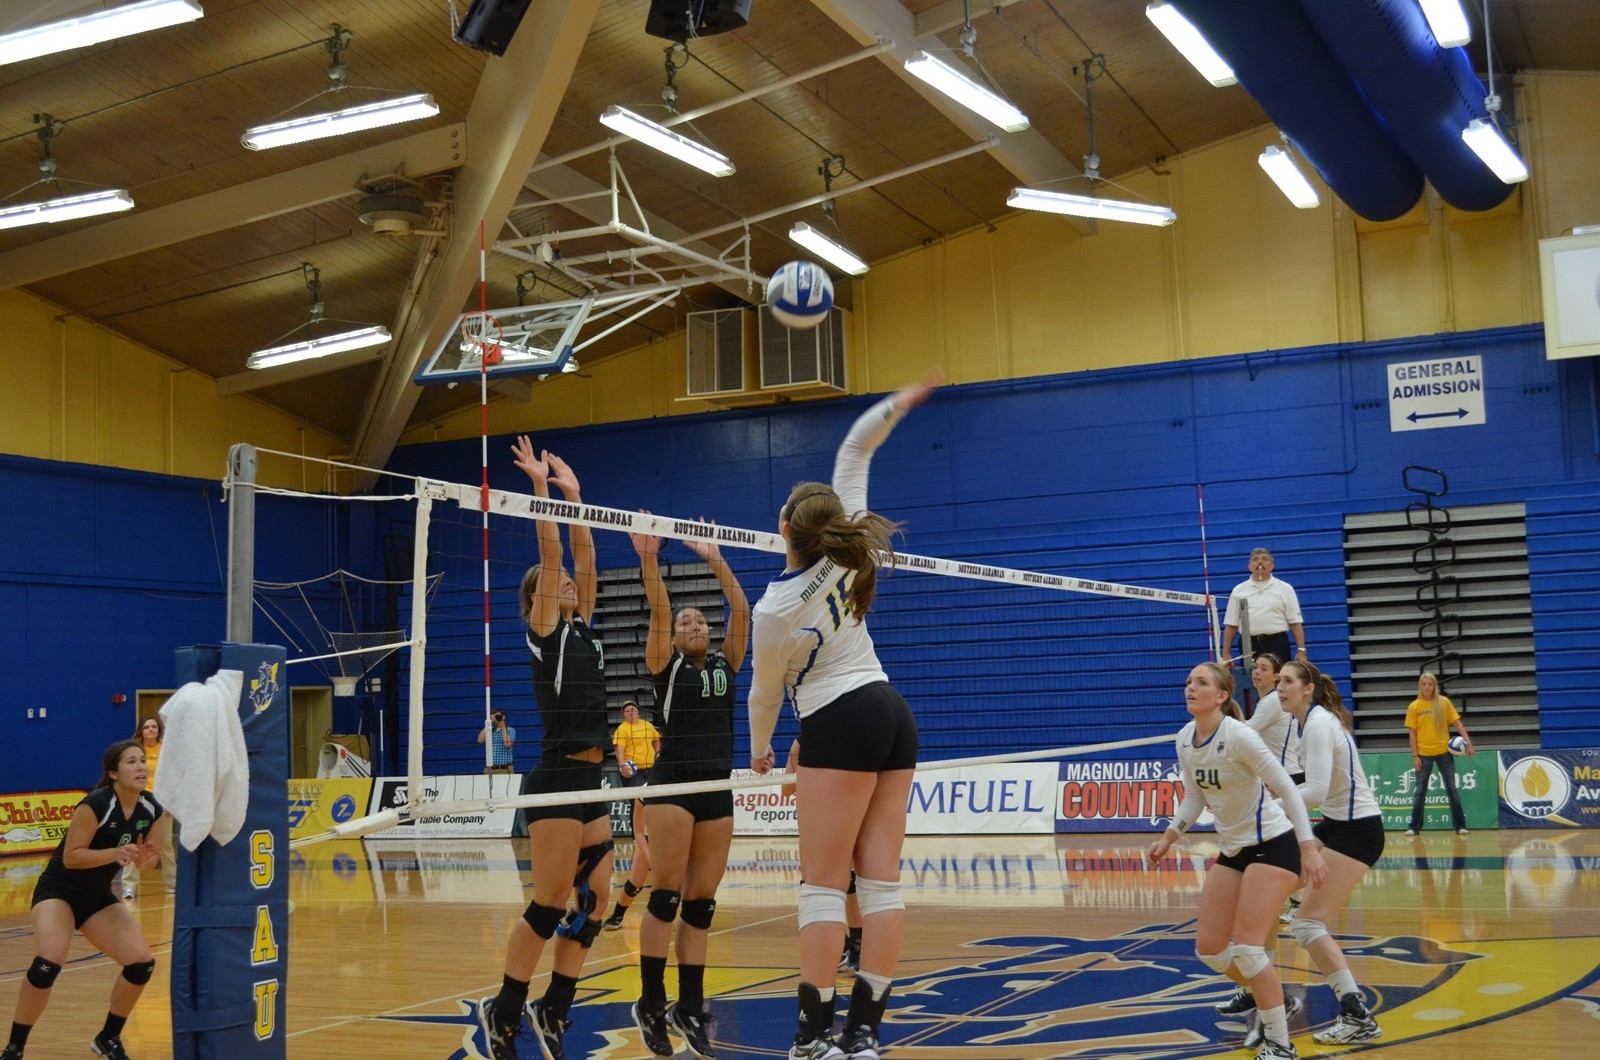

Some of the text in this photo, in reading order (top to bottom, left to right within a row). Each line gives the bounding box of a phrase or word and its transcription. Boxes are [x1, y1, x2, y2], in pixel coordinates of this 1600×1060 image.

[1394, 360, 1475, 381] GENERAL
[1392, 379, 1481, 400] ADMISSION
[529, 499, 633, 527] SOUTHERN ARKANSAS
[673, 521, 756, 545] SOUTHERN ARKANSAS
[701, 668, 728, 698] 10
[1066, 761, 1162, 781] MAGNOLIA'S
[1195, 769, 1222, 790] 24
[424, 788, 440, 797] The
[905, 779, 1045, 814] MFUEL
[1384, 795, 1413, 805] News
[0, 799, 77, 825] Chicke
[443, 814, 486, 825] Company
